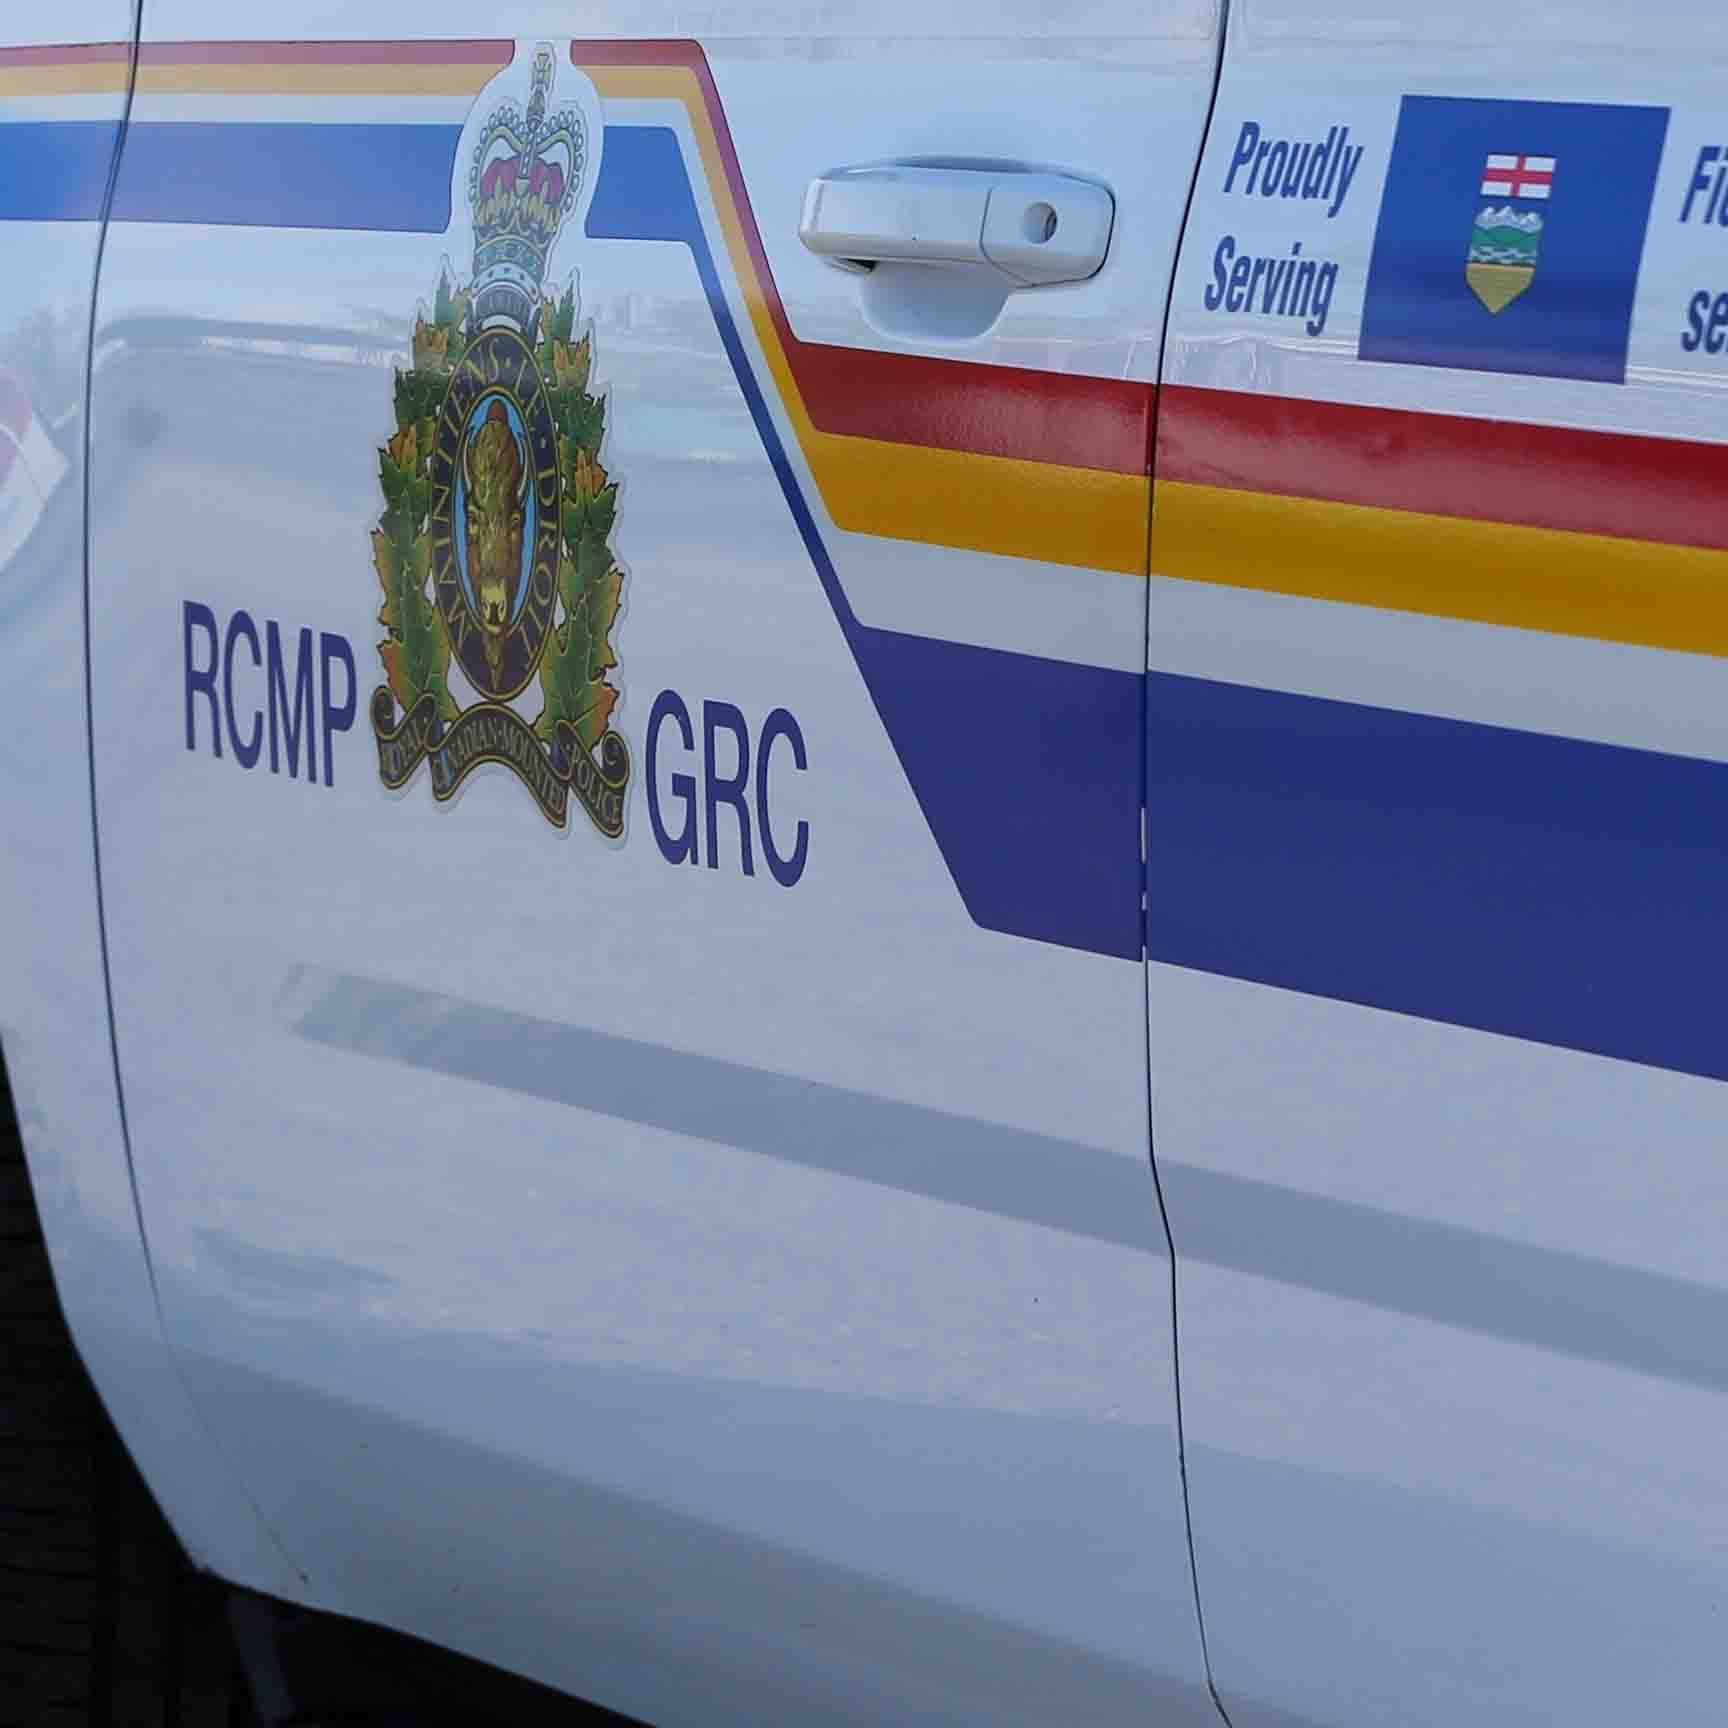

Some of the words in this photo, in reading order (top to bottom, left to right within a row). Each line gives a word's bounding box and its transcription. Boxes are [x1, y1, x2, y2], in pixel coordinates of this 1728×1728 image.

[1223, 121, 1364, 218] Proudly
[1204, 235, 1339, 336] Serving
[183, 600, 357, 787] RCMP
[645, 689, 809, 887] GRC
